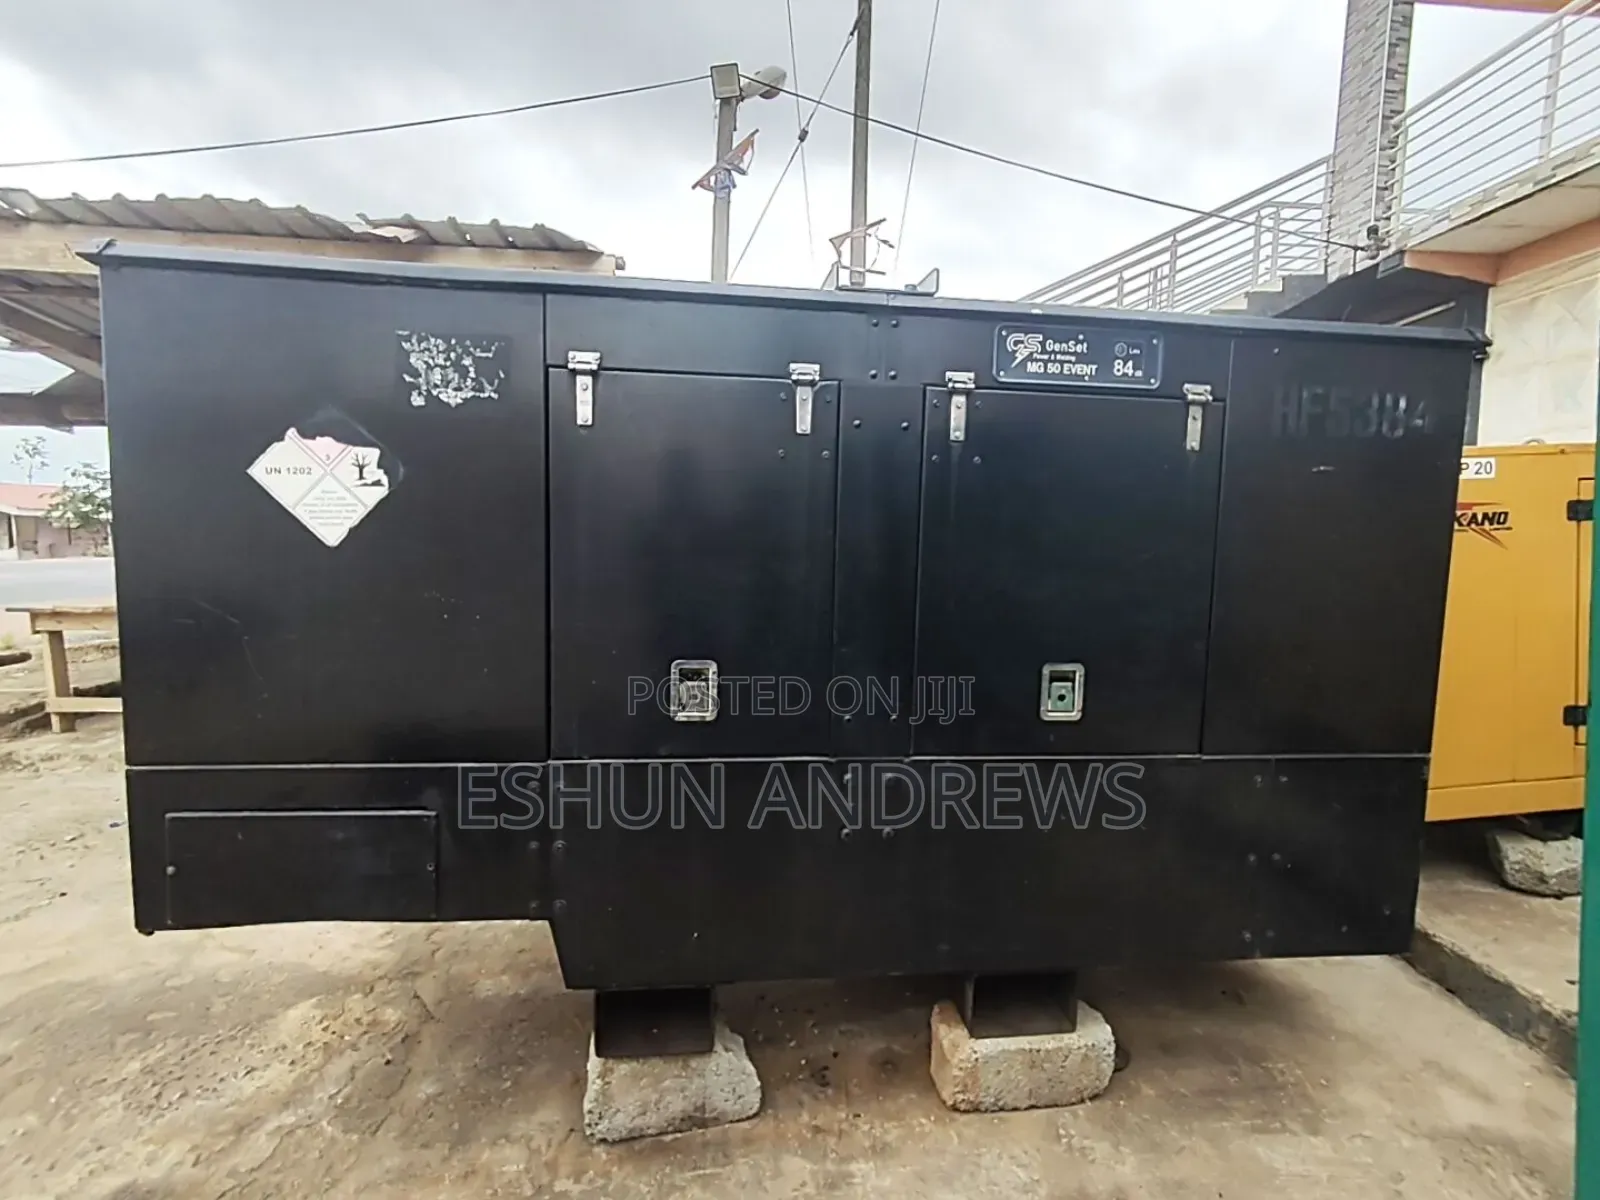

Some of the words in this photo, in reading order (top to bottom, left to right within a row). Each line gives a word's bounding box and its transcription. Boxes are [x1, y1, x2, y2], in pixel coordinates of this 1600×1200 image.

[1045, 339, 1088, 354] GenSet
[1026, 361, 1044, 373] MG
[1047, 362, 1061, 374] 50
[1063, 363, 1098, 375] EVENT
[1113, 359, 1134, 377] 84
[265, 466, 282, 475] UN
[286, 467, 312, 475] 1202
[1474, 461, 1493, 475] 20
